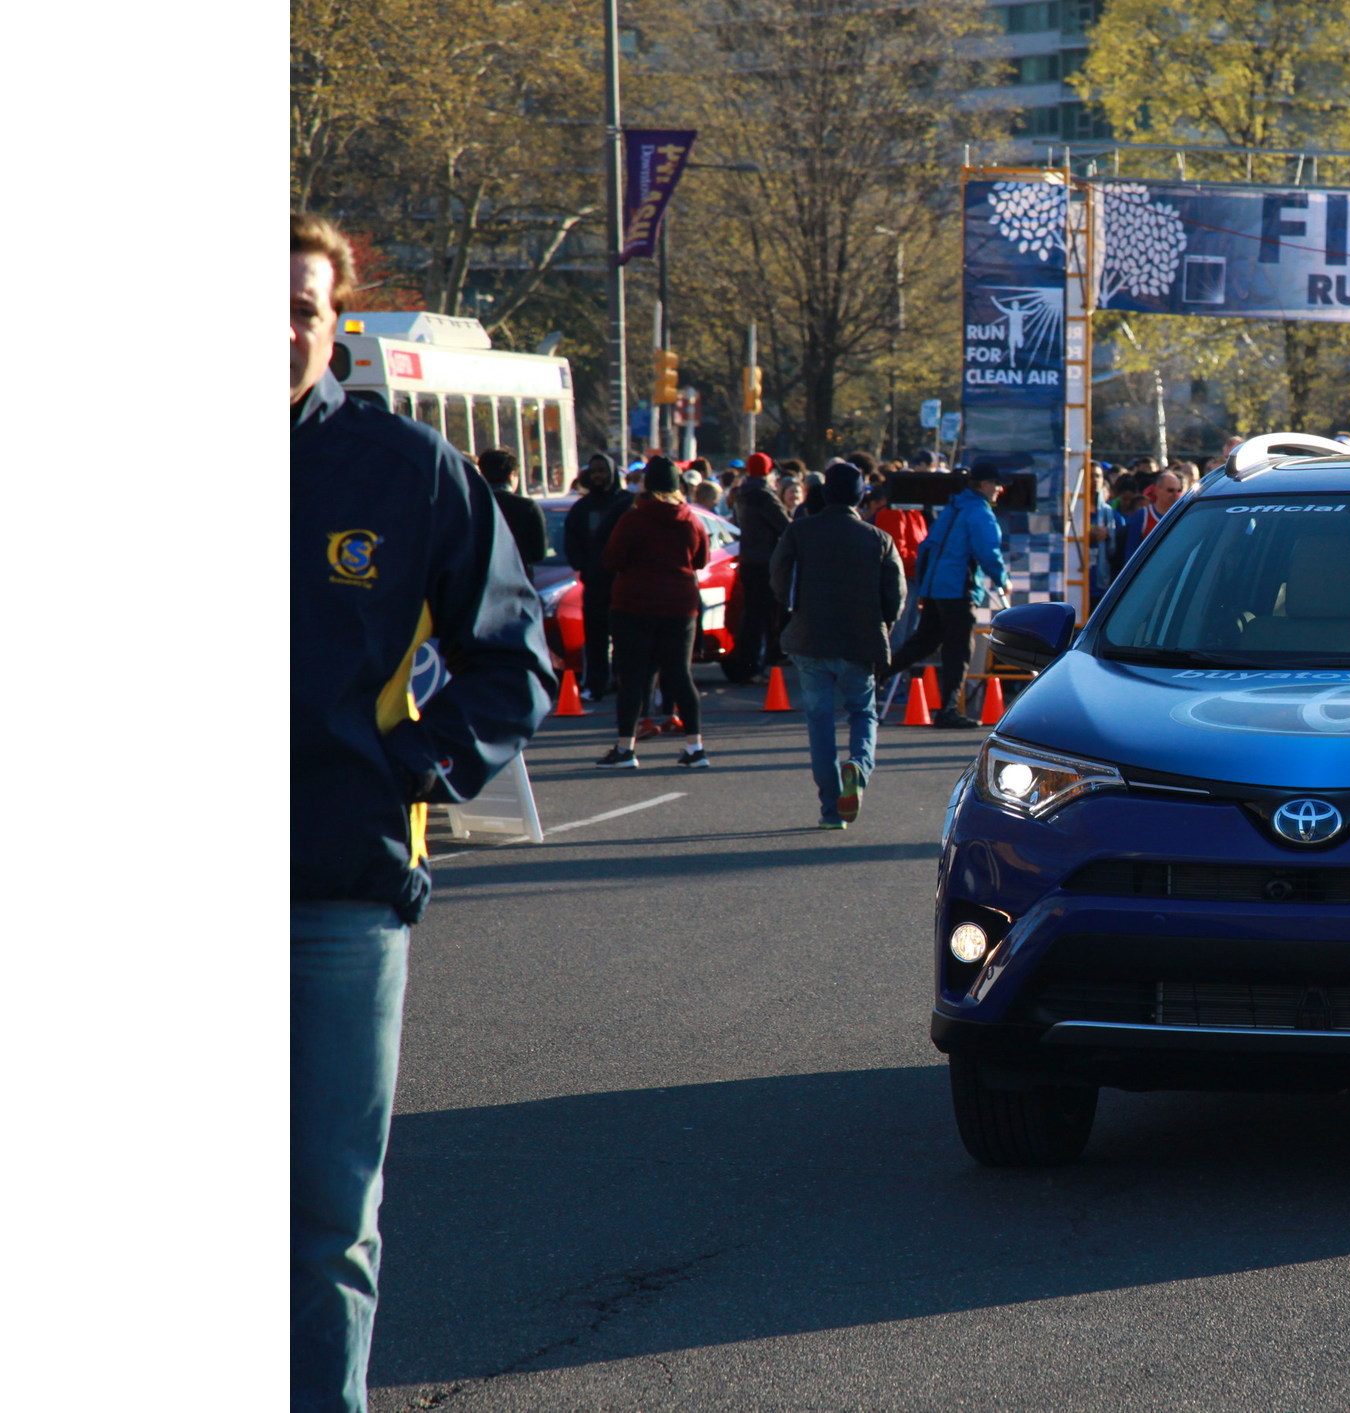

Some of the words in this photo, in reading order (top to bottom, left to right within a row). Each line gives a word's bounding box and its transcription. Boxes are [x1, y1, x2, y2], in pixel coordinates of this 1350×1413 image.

[966, 325, 1006, 341] RUN
[966, 347, 1002, 363] FOR
[965, 369, 1023, 385] CLEAN
[1026, 370, 1060, 386] AIR
[1225, 504, 1347, 514] Official
